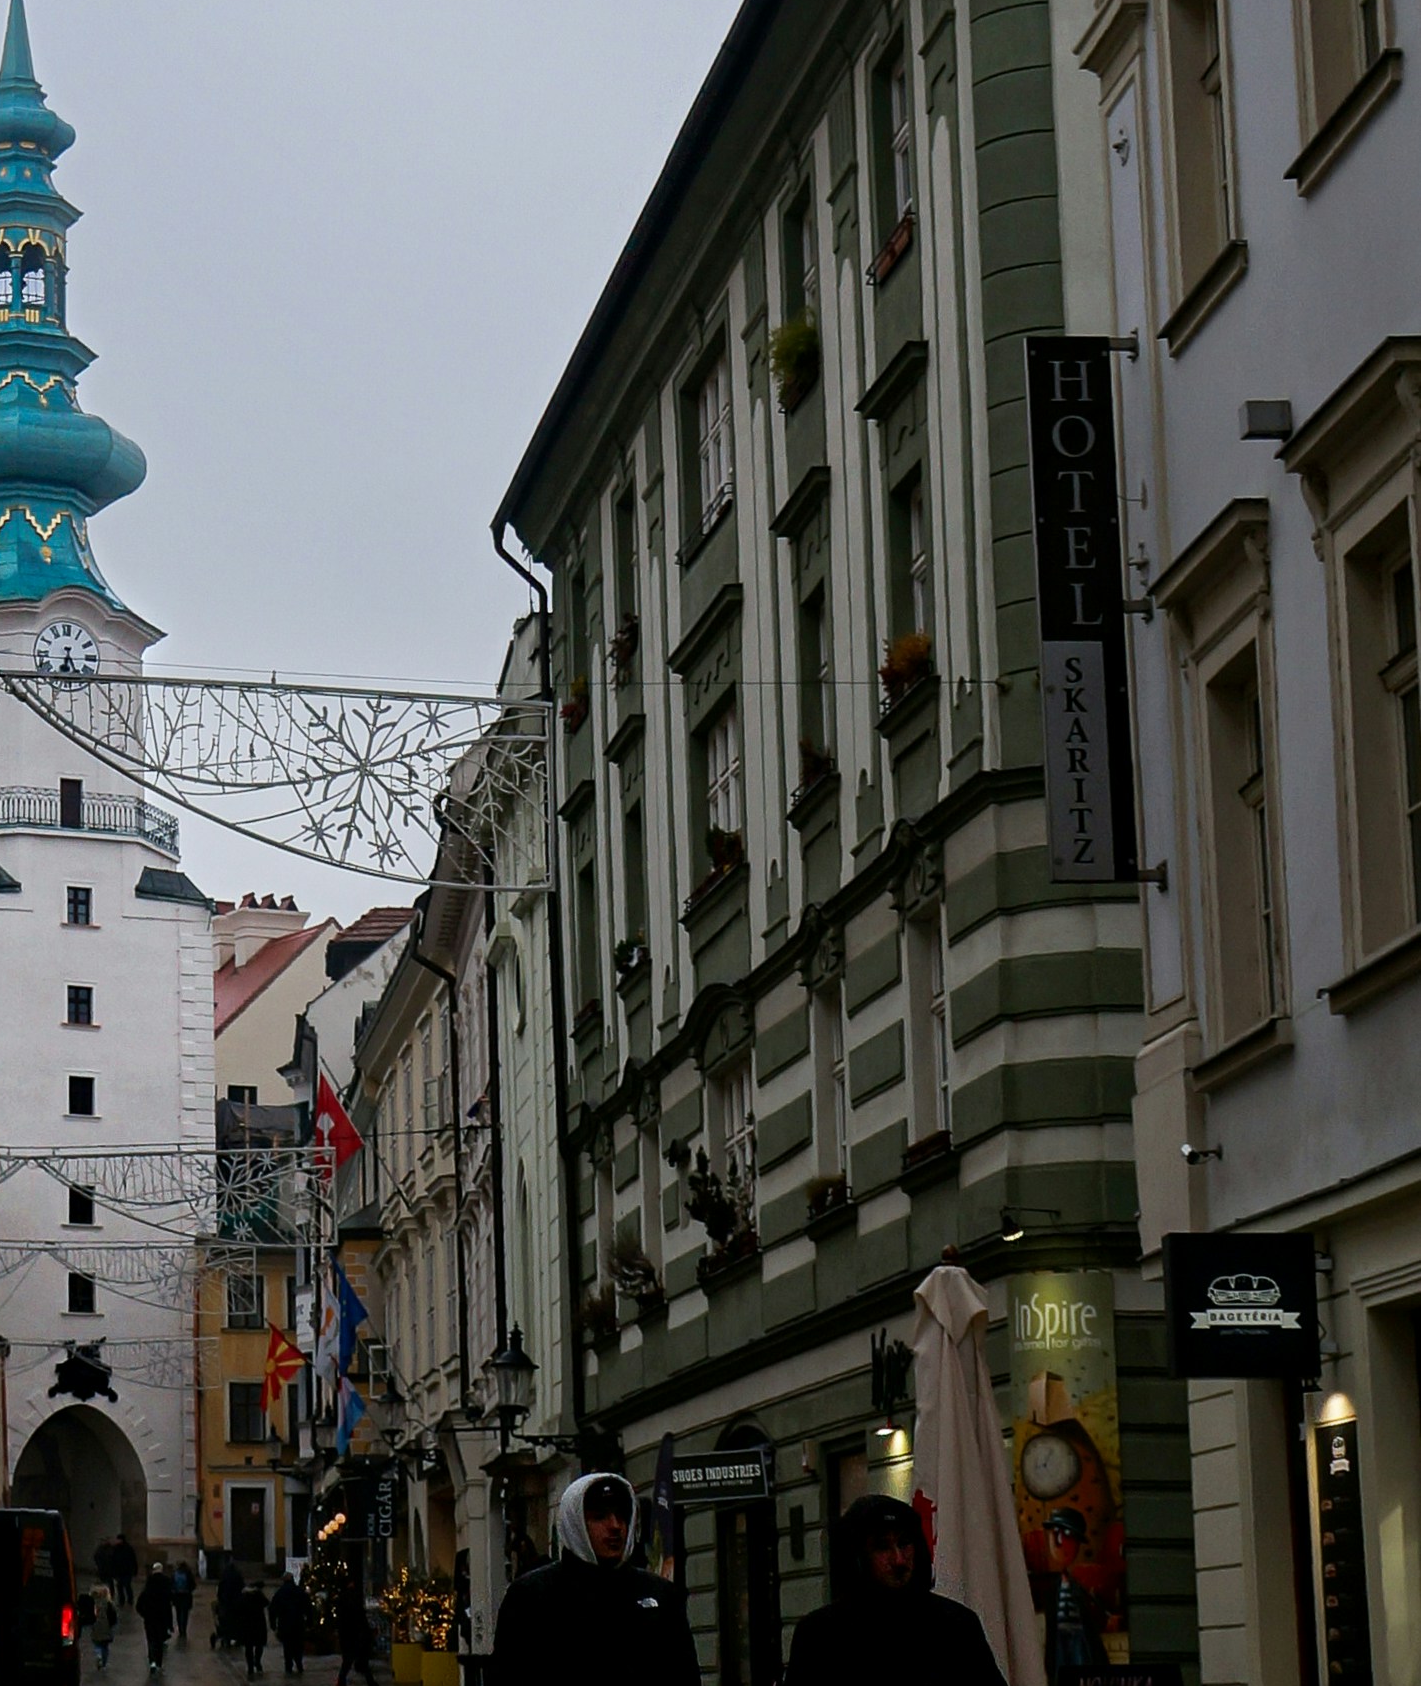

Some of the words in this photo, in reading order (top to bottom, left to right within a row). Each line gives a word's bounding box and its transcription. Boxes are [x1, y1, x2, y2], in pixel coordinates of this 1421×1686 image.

[1047, 359, 1104, 627] HOTEL
[1064, 656, 1095, 866] SKARITZ
[1014, 1292, 1098, 1350] InSpire
[1209, 1311, 1281, 1322] BAGETÉRIA
[672, 1468, 704, 1483] SHOES
[705, 1464, 761, 1480] INDUSTRIES
